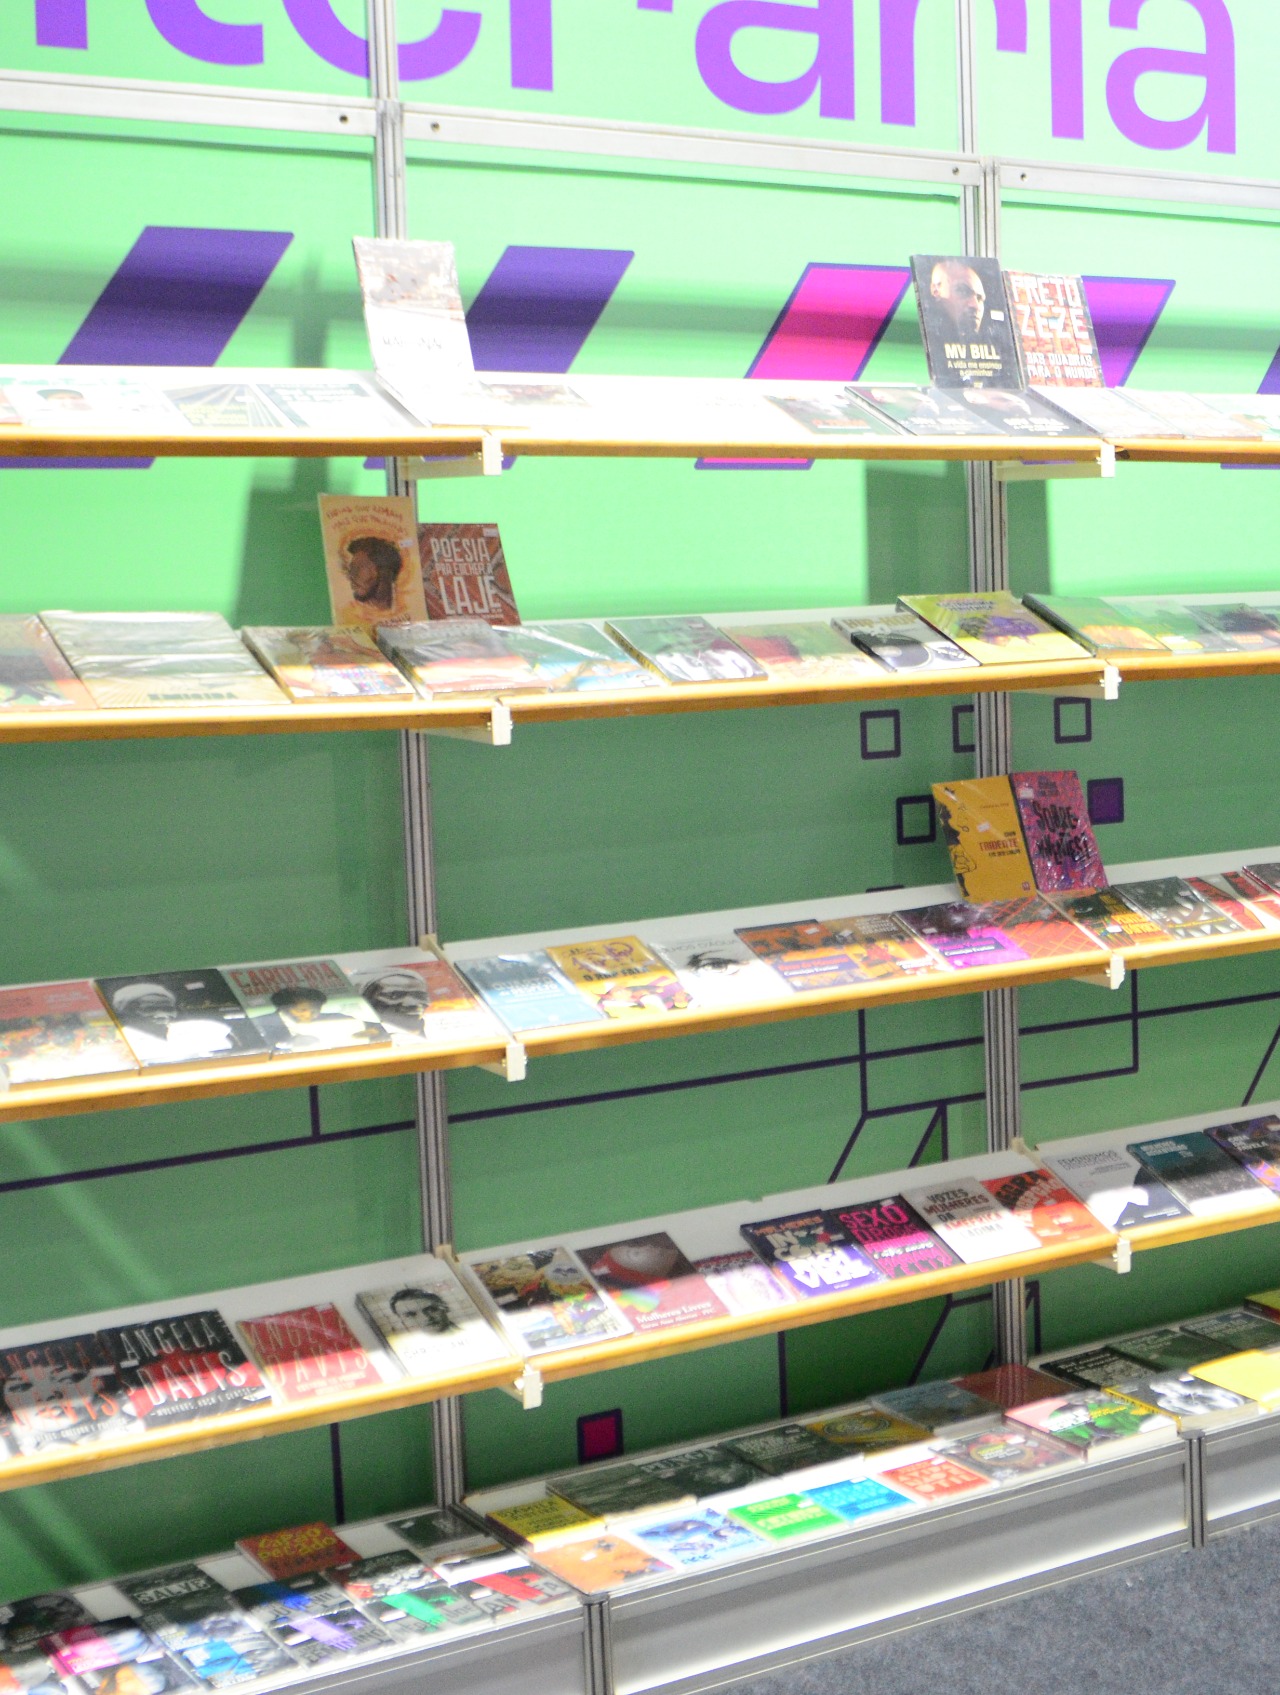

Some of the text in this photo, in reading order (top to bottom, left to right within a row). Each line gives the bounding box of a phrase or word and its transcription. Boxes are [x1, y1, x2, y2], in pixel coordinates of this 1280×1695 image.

[944, 343, 1000, 360] MV BILL
[430, 537, 491, 563] POESIA
[438, 576, 503, 615] LAJE
[120, 1318, 221, 1361] ANGELA
[136, 1351, 247, 1406] DAVIS
